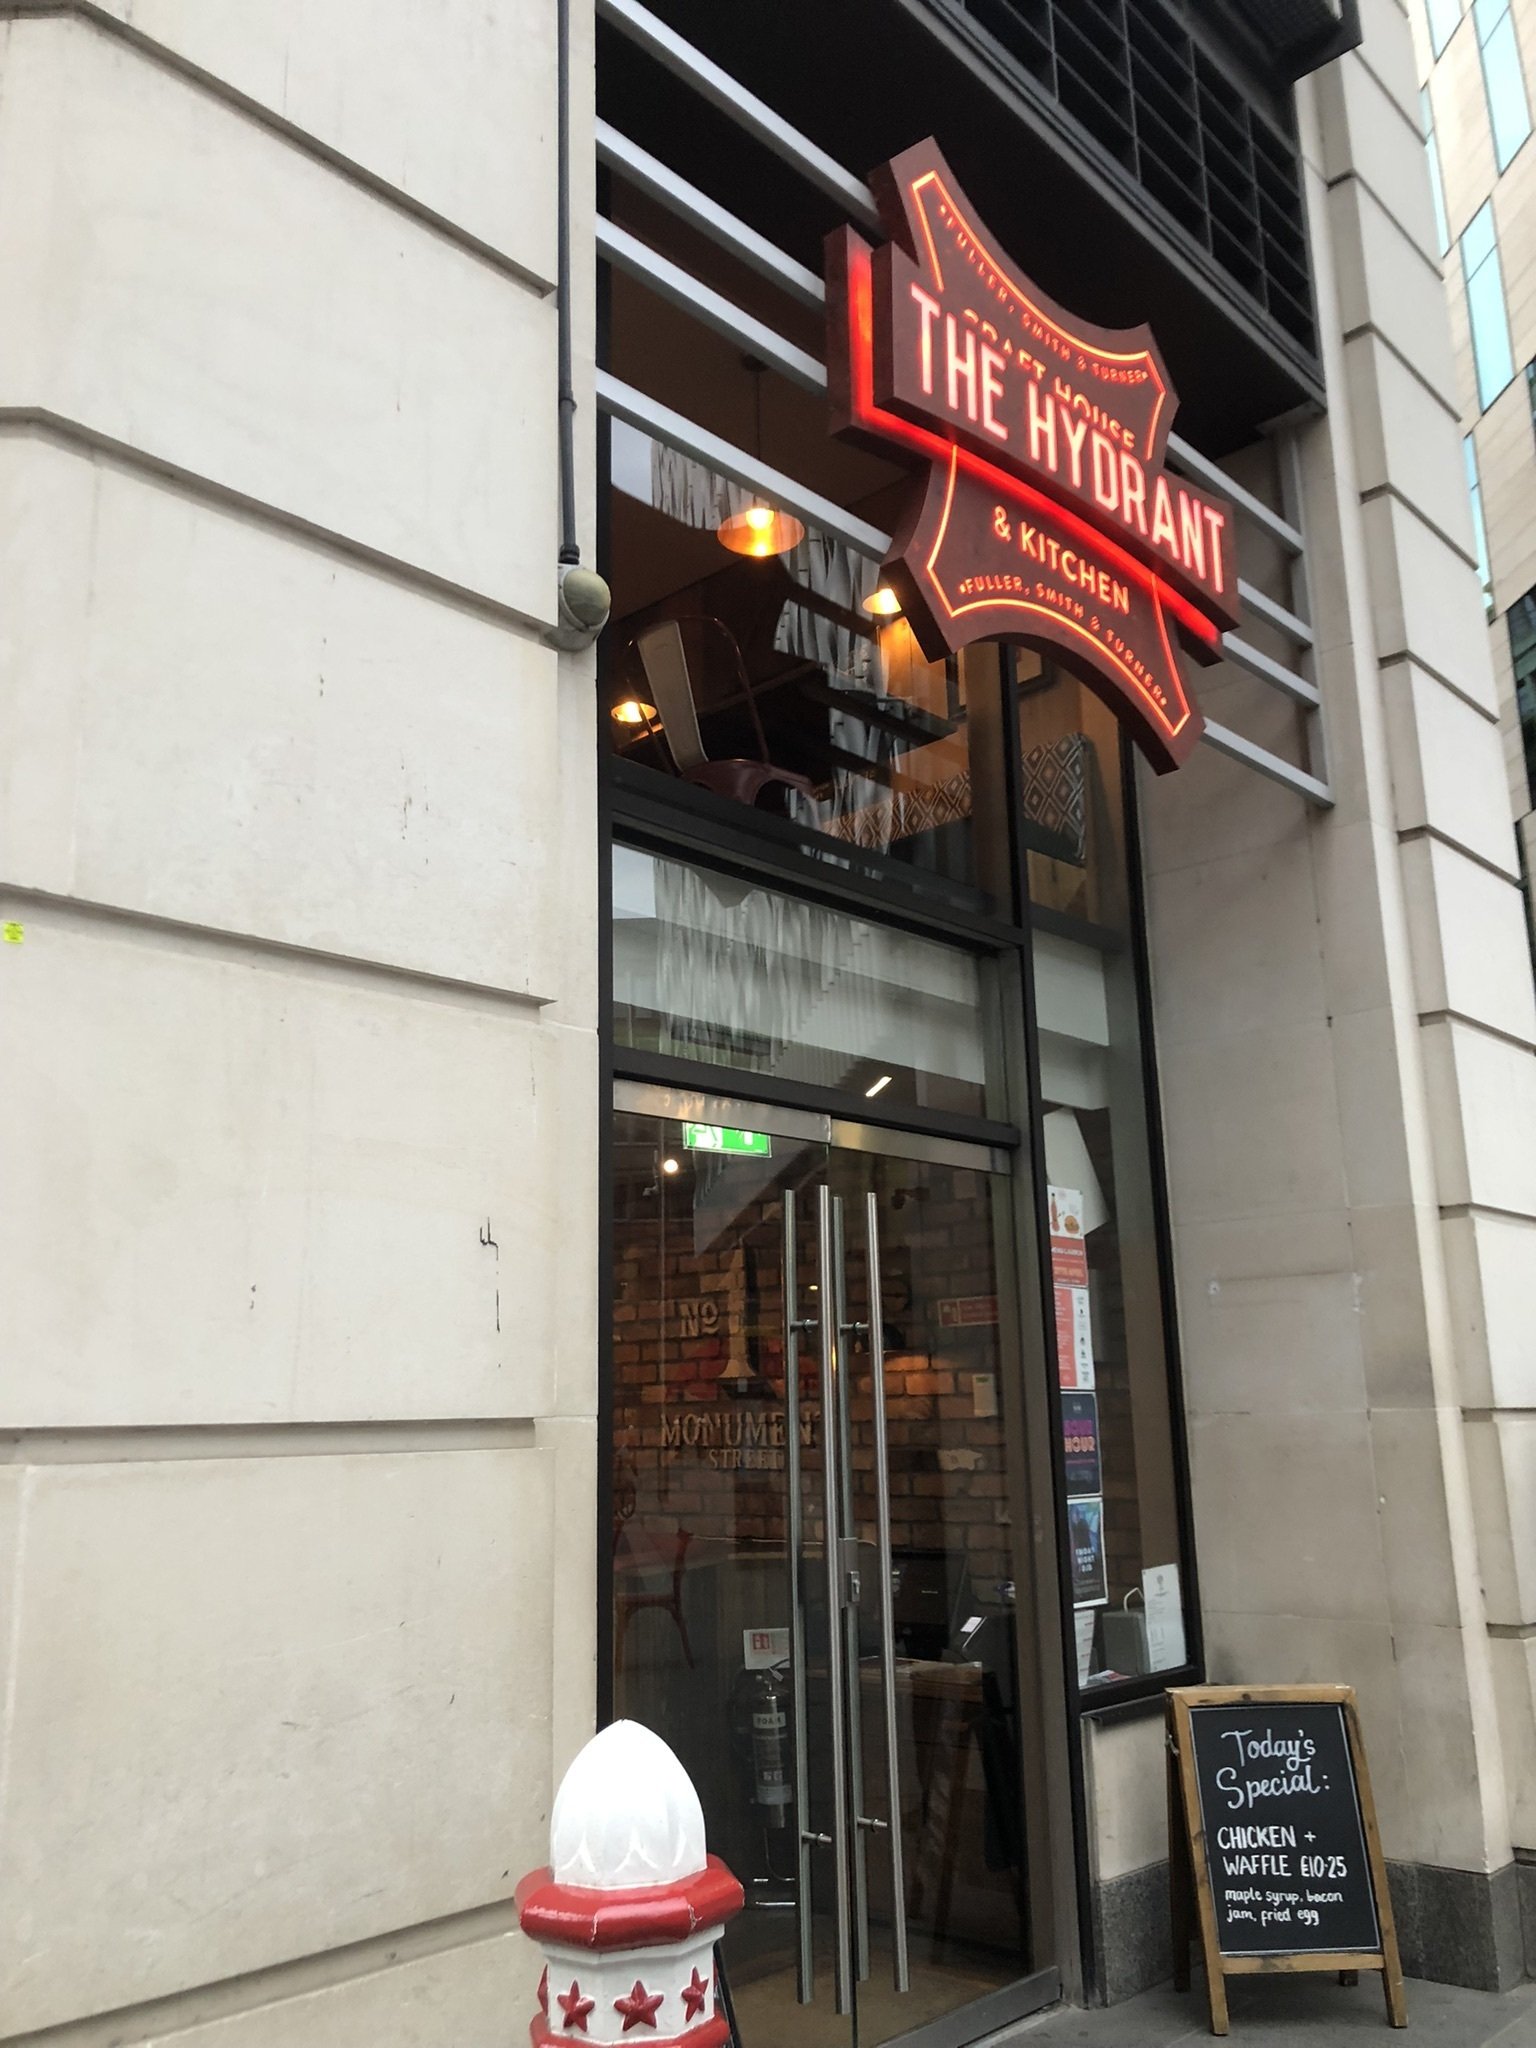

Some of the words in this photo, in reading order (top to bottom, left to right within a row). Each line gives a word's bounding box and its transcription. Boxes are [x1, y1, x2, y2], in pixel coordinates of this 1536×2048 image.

[910, 281, 1009, 440] THE
[1029, 379, 1225, 594] HYDRANT
[994, 505, 1012, 542] &
[1020, 520, 1130, 616] KITCHEN
[1035, 581, 1085, 620] SMITH
[1105, 628, 1164, 702] TURNER
[660, 1411, 823, 1449] MONUMEN
[1063, 1435, 1096, 1453] HOUR
[1220, 1728, 1317, 1771] Today's
[1215, 1764, 1331, 1810] Special:
[1217, 1825, 1298, 1850] CHICKEN
[1303, 1830, 1318, 1844] +
[1222, 1854, 1293, 1877] WAFFLE
[1224, 1886, 1264, 1905] maple
[1306, 1888, 1345, 1904] bacon
[1260, 1907, 1293, 1928] fried
[1296, 1908, 1321, 1927] egg
